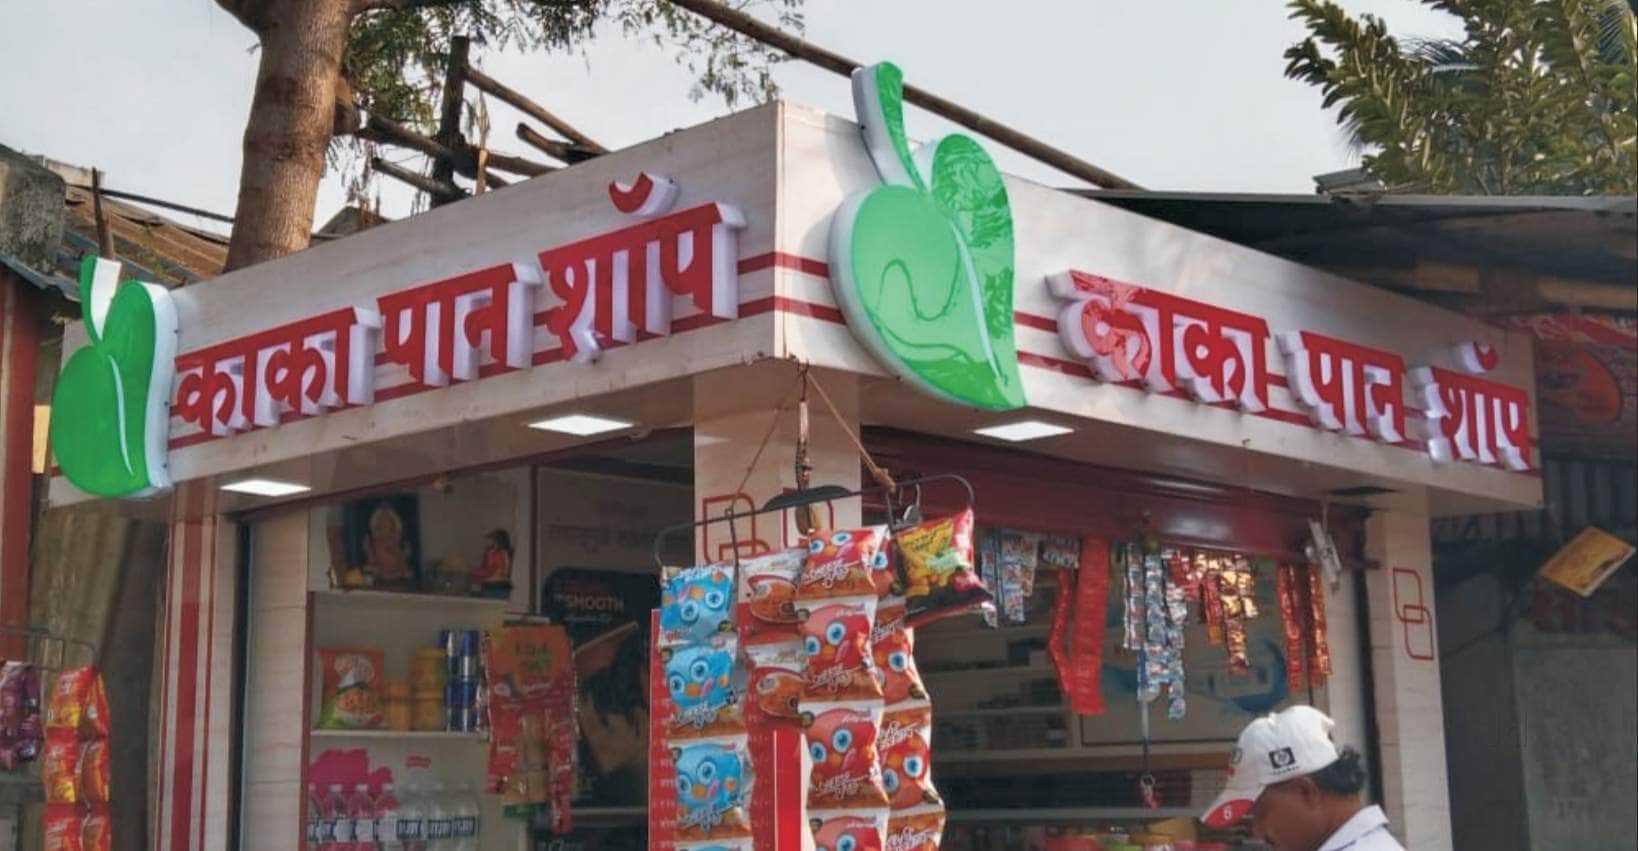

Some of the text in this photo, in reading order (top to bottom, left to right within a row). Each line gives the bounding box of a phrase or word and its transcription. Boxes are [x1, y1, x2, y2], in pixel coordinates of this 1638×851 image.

[173, 171, 738, 437] काका पान शॉप
[1054, 270, 1531, 474] काका पान शॉप
